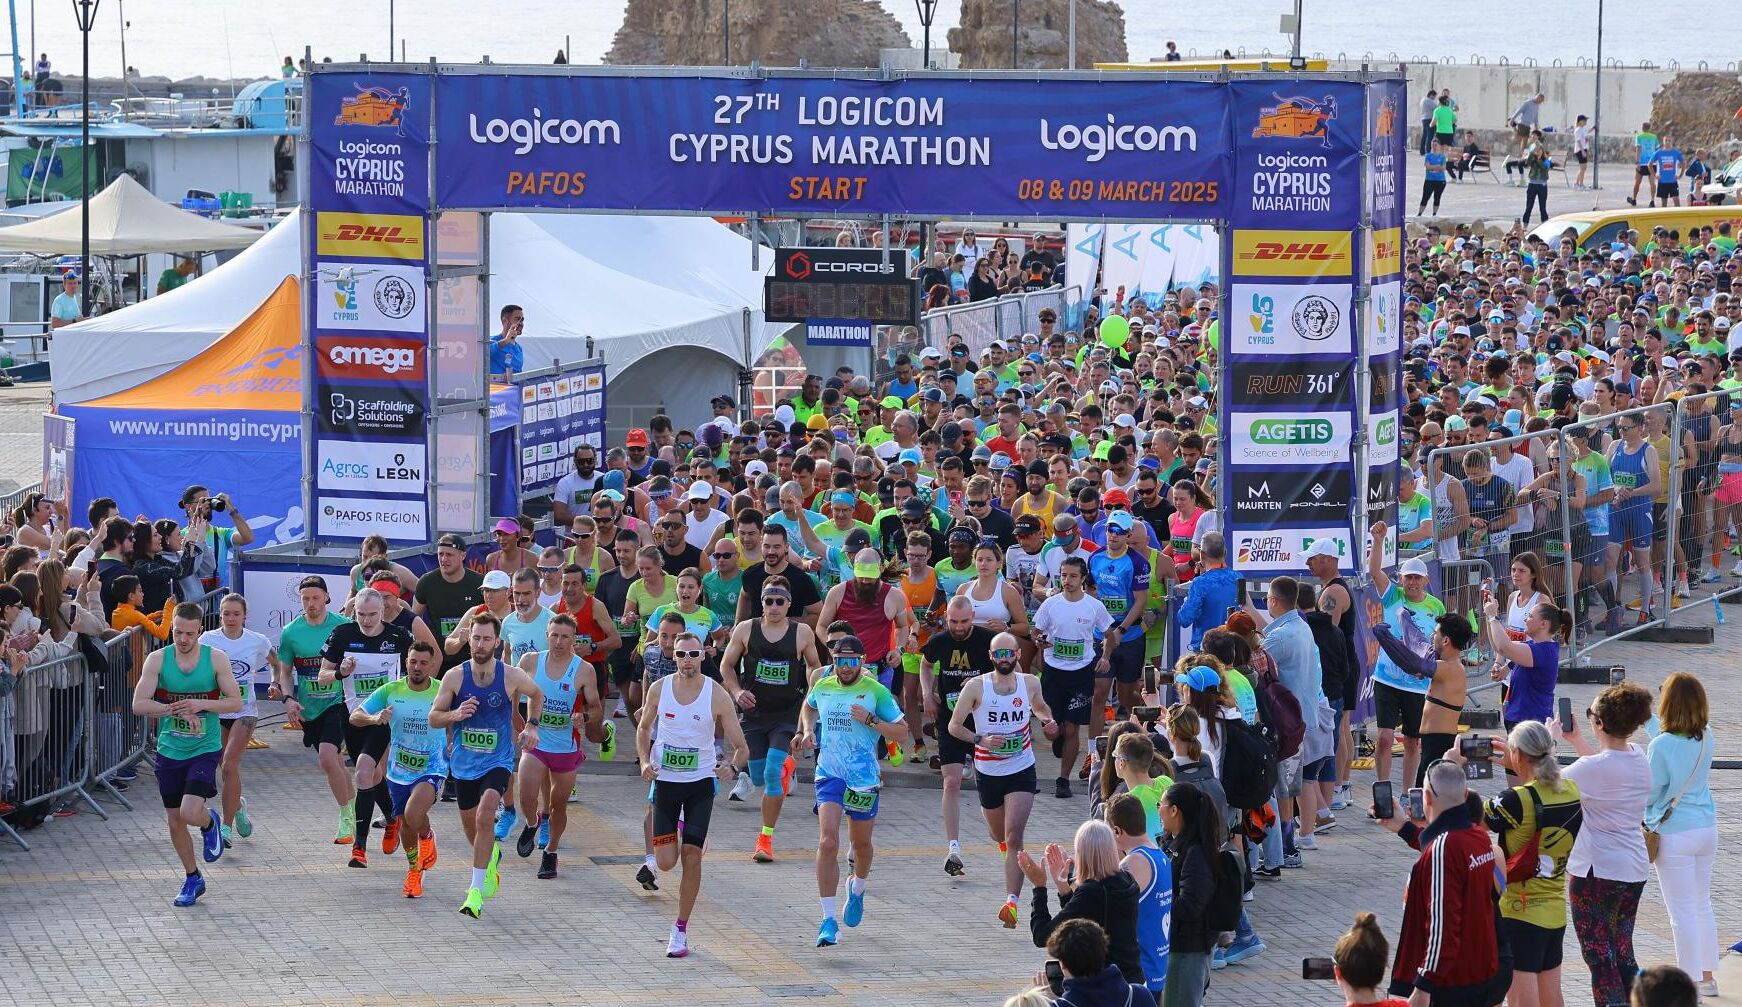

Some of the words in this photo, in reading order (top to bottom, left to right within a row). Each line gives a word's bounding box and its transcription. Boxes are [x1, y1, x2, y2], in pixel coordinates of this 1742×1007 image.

[714, 92, 779, 124] 27TH
[798, 96, 944, 126] LOGICOM
[469, 107, 620, 155] Logicom
[1040, 113, 1196, 162] Logicom
[339, 139, 401, 159] Logicom
[669, 133, 793, 164] CYPRUS
[812, 135, 990, 166] MARATHON
[335, 158, 404, 181] CYPRUS
[1258, 151, 1327, 173] Logicom
[335, 179, 404, 197] MARATHON
[507, 171, 586, 196] PAFOS
[789, 176, 868, 200] START
[1018, 179, 1043, 200] 08
[1049, 180, 1063, 200] &
[1068, 180, 1094, 200] 09
[1098, 181, 1164, 202] MARCH
[1169, 181, 1218, 202] 2025
[1253, 172, 1331, 195] CYPRUS
[1252, 197, 1330, 211] MARATHON
[337, 224, 405, 244] DHL
[1254, 242, 1332, 260] DHL
[814, 262, 895, 273] COROS
[333, 312, 359, 321] CYPRUS
[808, 325, 870, 340] MARATHON
[1248, 336, 1275, 345] CYPRUS
[329, 345, 414, 374] omega
[1247, 375, 1303, 395] RUN
[357, 400, 415, 414] Scaffolding
[357, 411, 404, 422] Solutions
[1256, 423, 1329, 440] AGETIS
[1243, 447, 1278, 458] Science
[1281, 447, 1291, 457] of
[1294, 447, 1339, 459] Wellbeing
[1237, 501, 1282, 510] MAURTEN
[336, 510, 373, 522] PAFOS
[375, 512, 420, 524] REGION
[1252, 537, 1283, 550] SUPER
[1057, 645, 1080, 655] 2118
[759, 665, 786, 677] 1586
[167, 693, 209, 701] STROUD
[827, 717, 852, 727] CYPRUS
[988, 710, 1024, 722] SAM
[403, 722, 428, 731] CYPRUS
[464, 732, 494, 745] 1006
[399, 752, 425, 768] 1902
[665, 753, 694, 766] 1807
[846, 791, 872, 807] 1972
